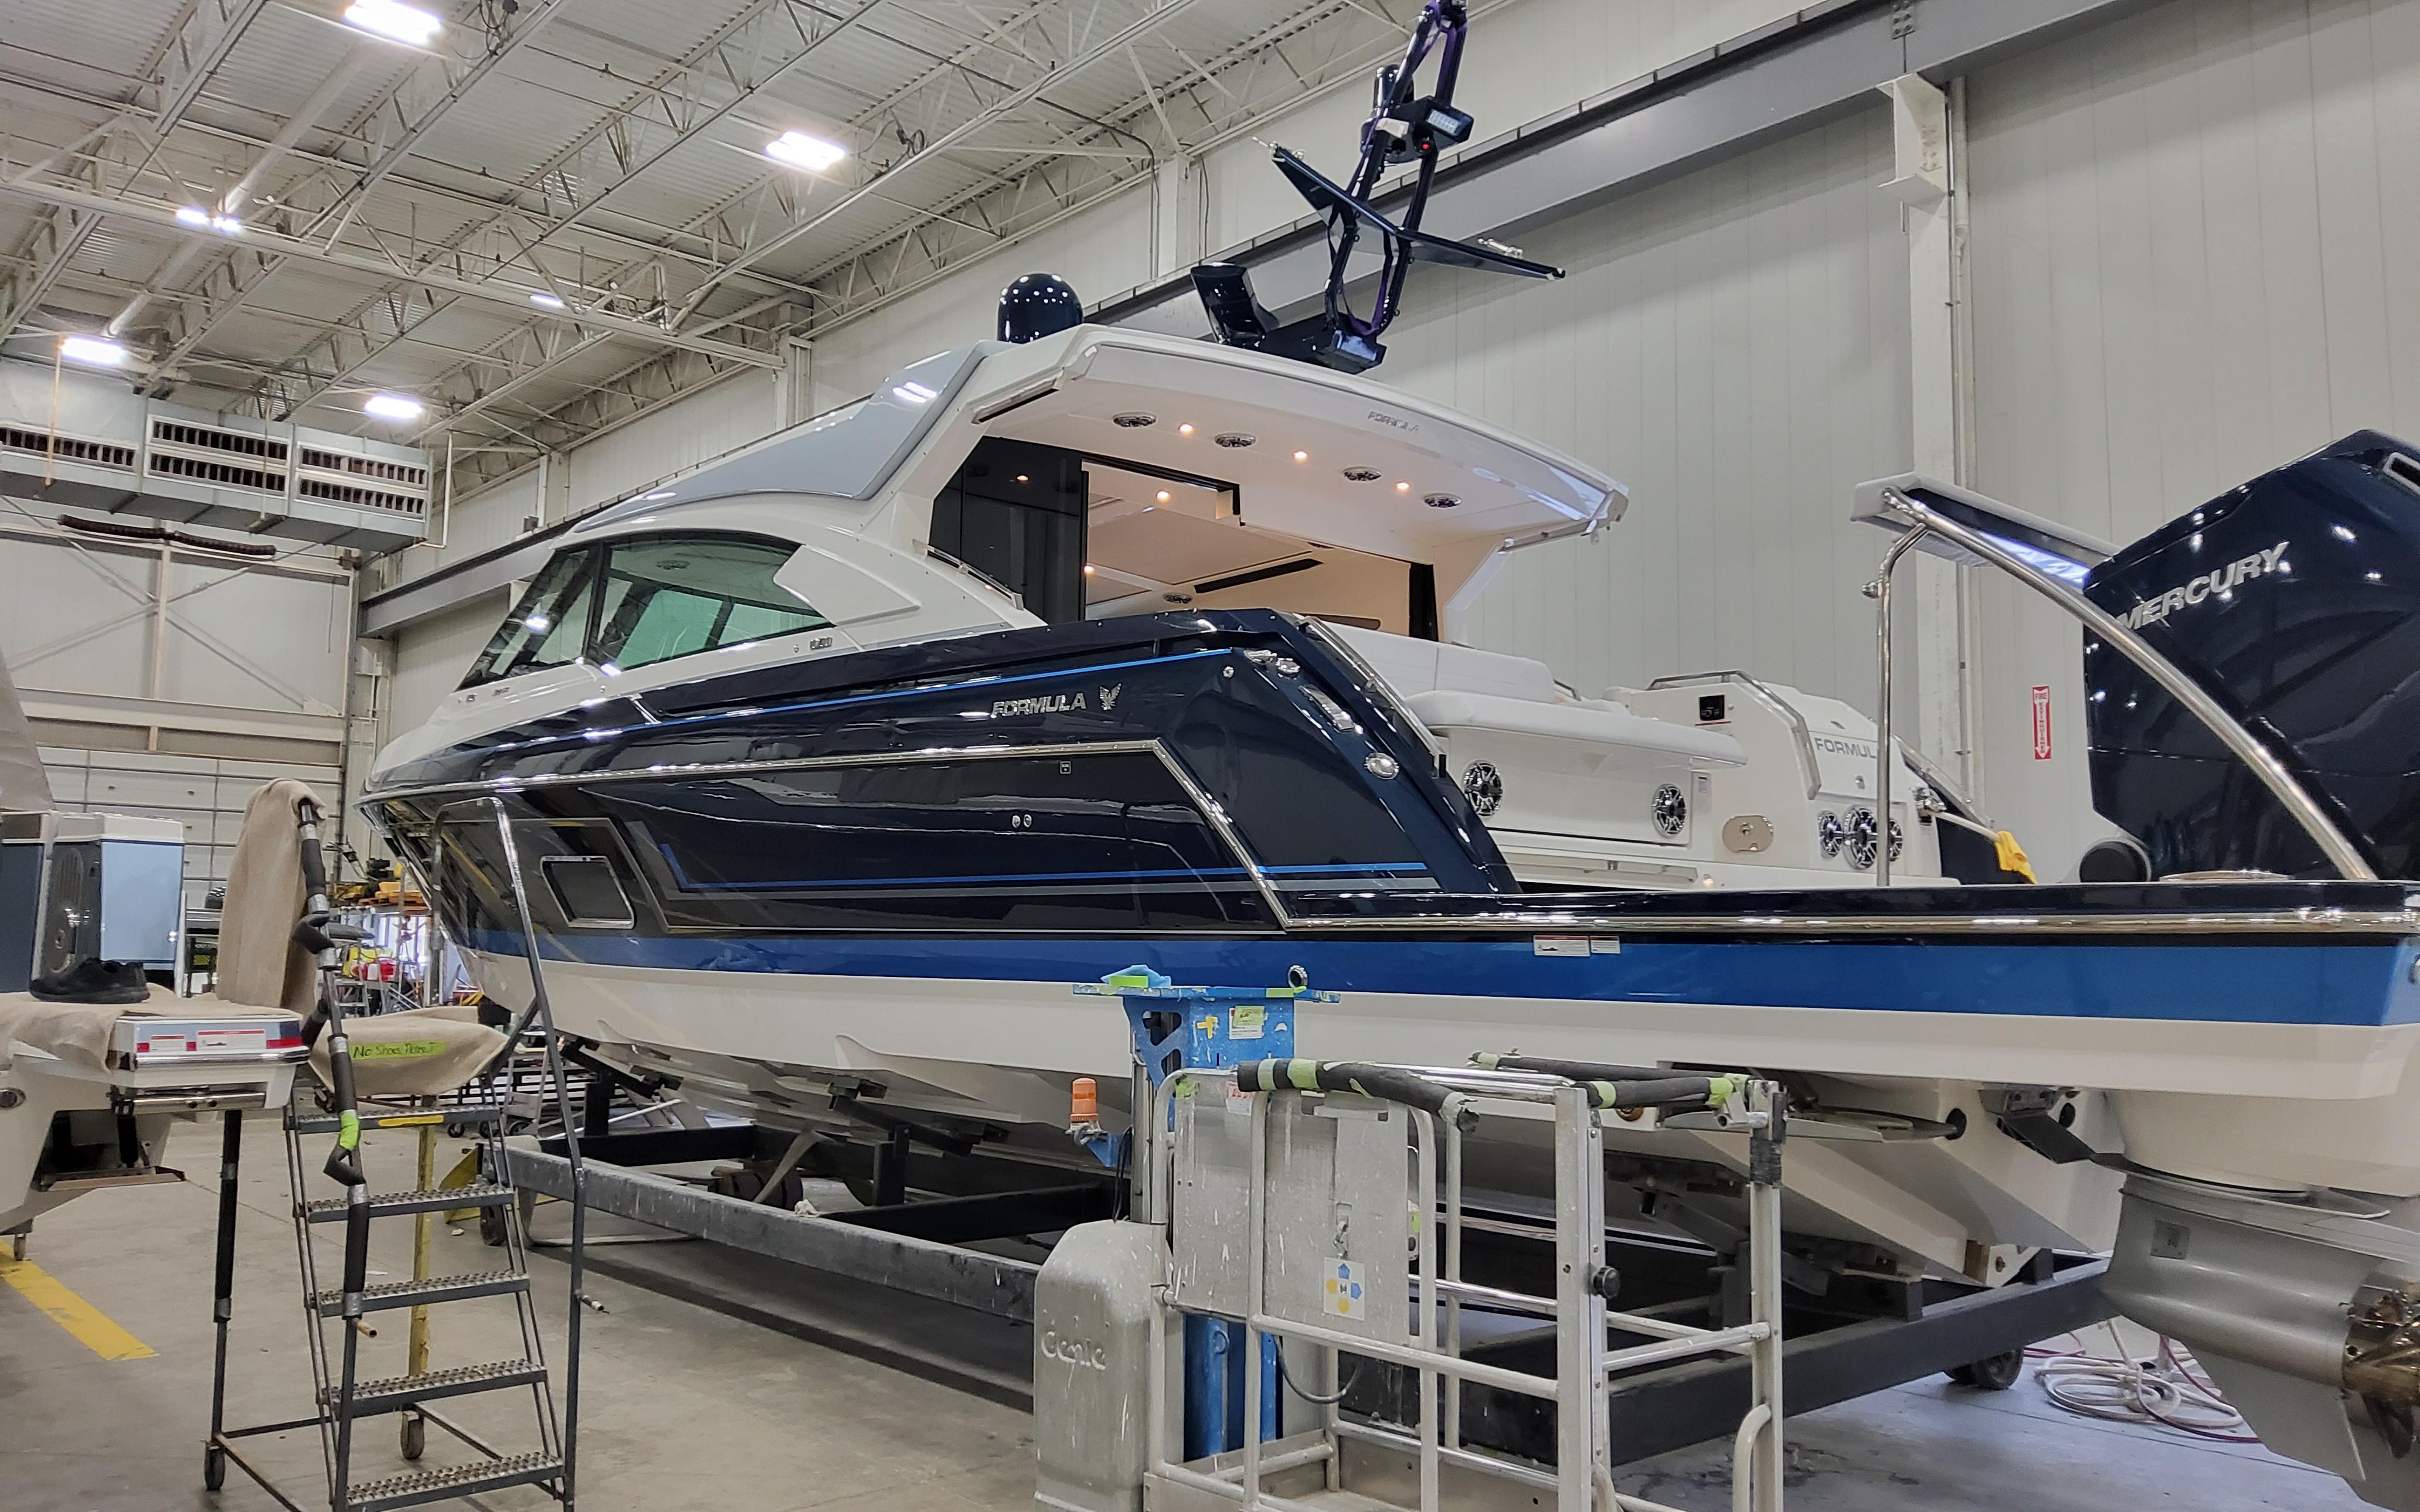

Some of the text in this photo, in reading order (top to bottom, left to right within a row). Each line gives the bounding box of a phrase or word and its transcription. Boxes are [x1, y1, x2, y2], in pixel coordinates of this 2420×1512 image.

[2116, 541, 2290, 631] MERCURY
[990, 693, 1087, 719] FORMULA
[1814, 737, 1878, 759] FORMUL
[353, 1045, 372, 1058] No
[1041, 1330, 1106, 1370] Genie
